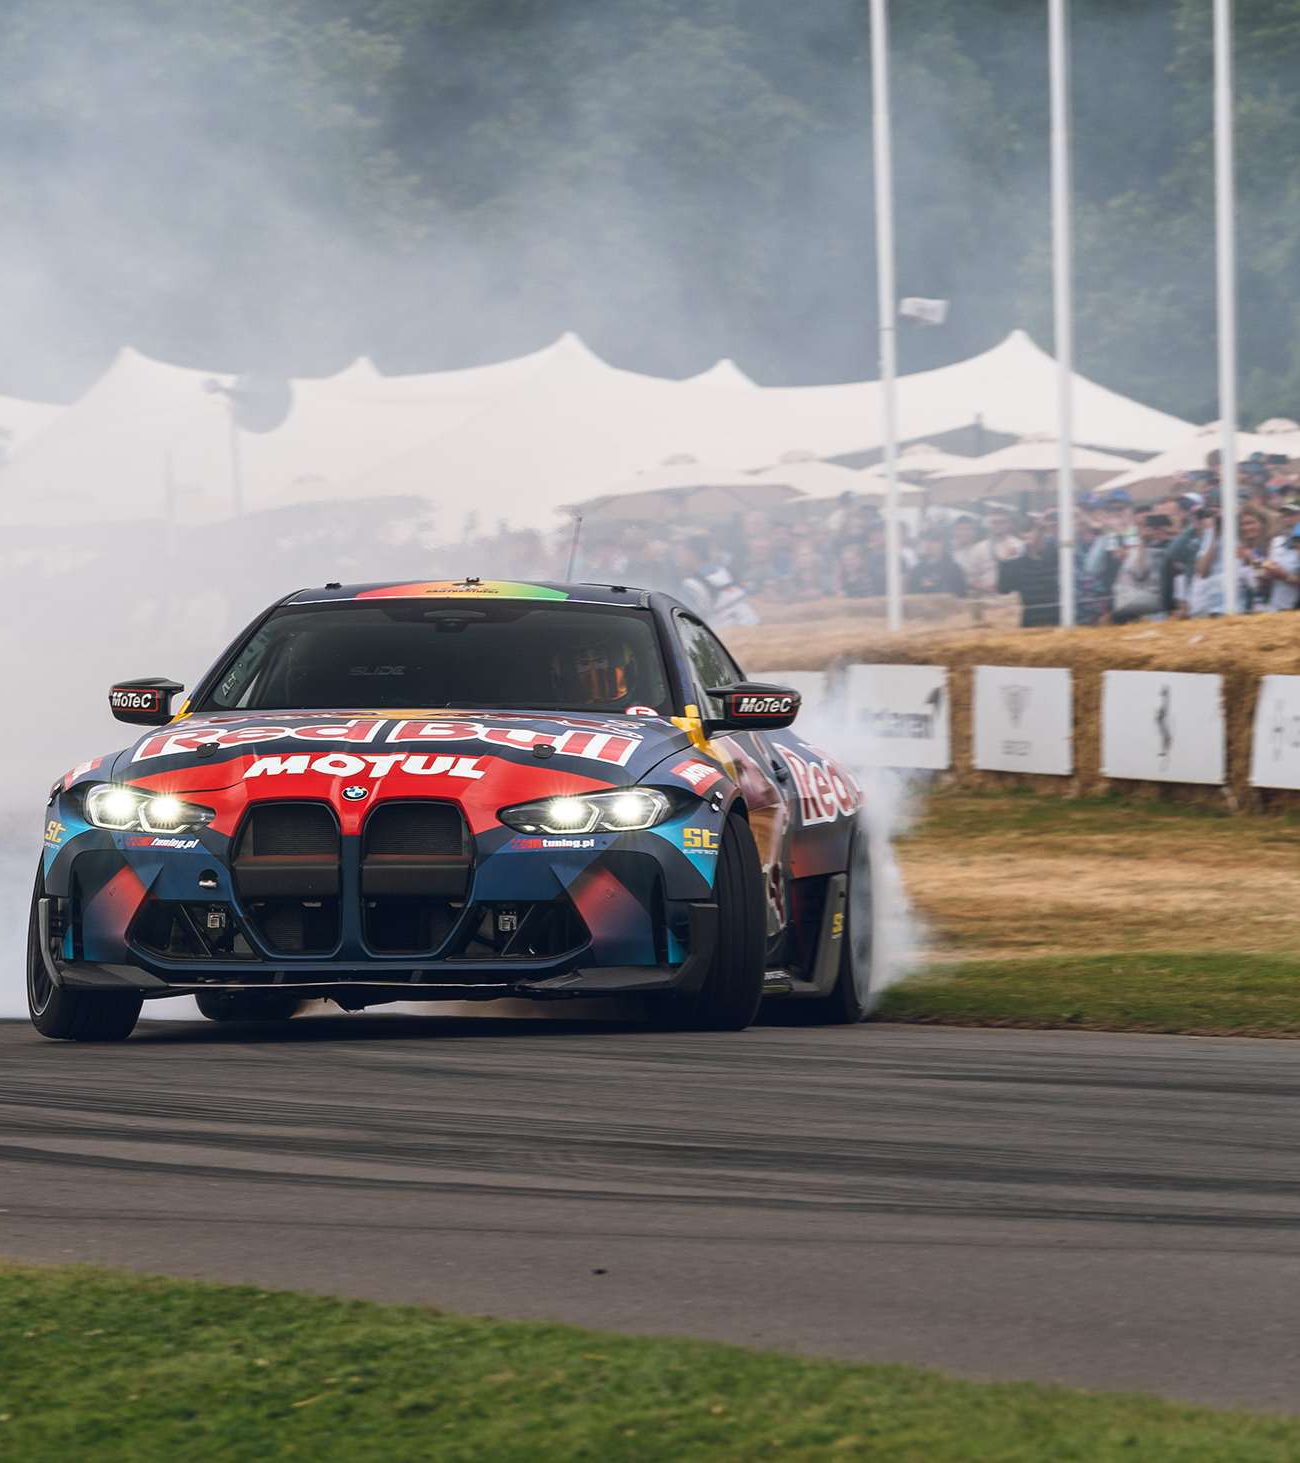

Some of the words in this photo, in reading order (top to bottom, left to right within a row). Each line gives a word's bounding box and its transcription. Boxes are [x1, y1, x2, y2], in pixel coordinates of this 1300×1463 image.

[112, 692, 152, 708] MoTeC
[739, 697, 792, 713] MoTeC
[131, 719, 388, 763] Red
[385, 720, 642, 767] Bull
[243, 753, 487, 780] MOTUL
